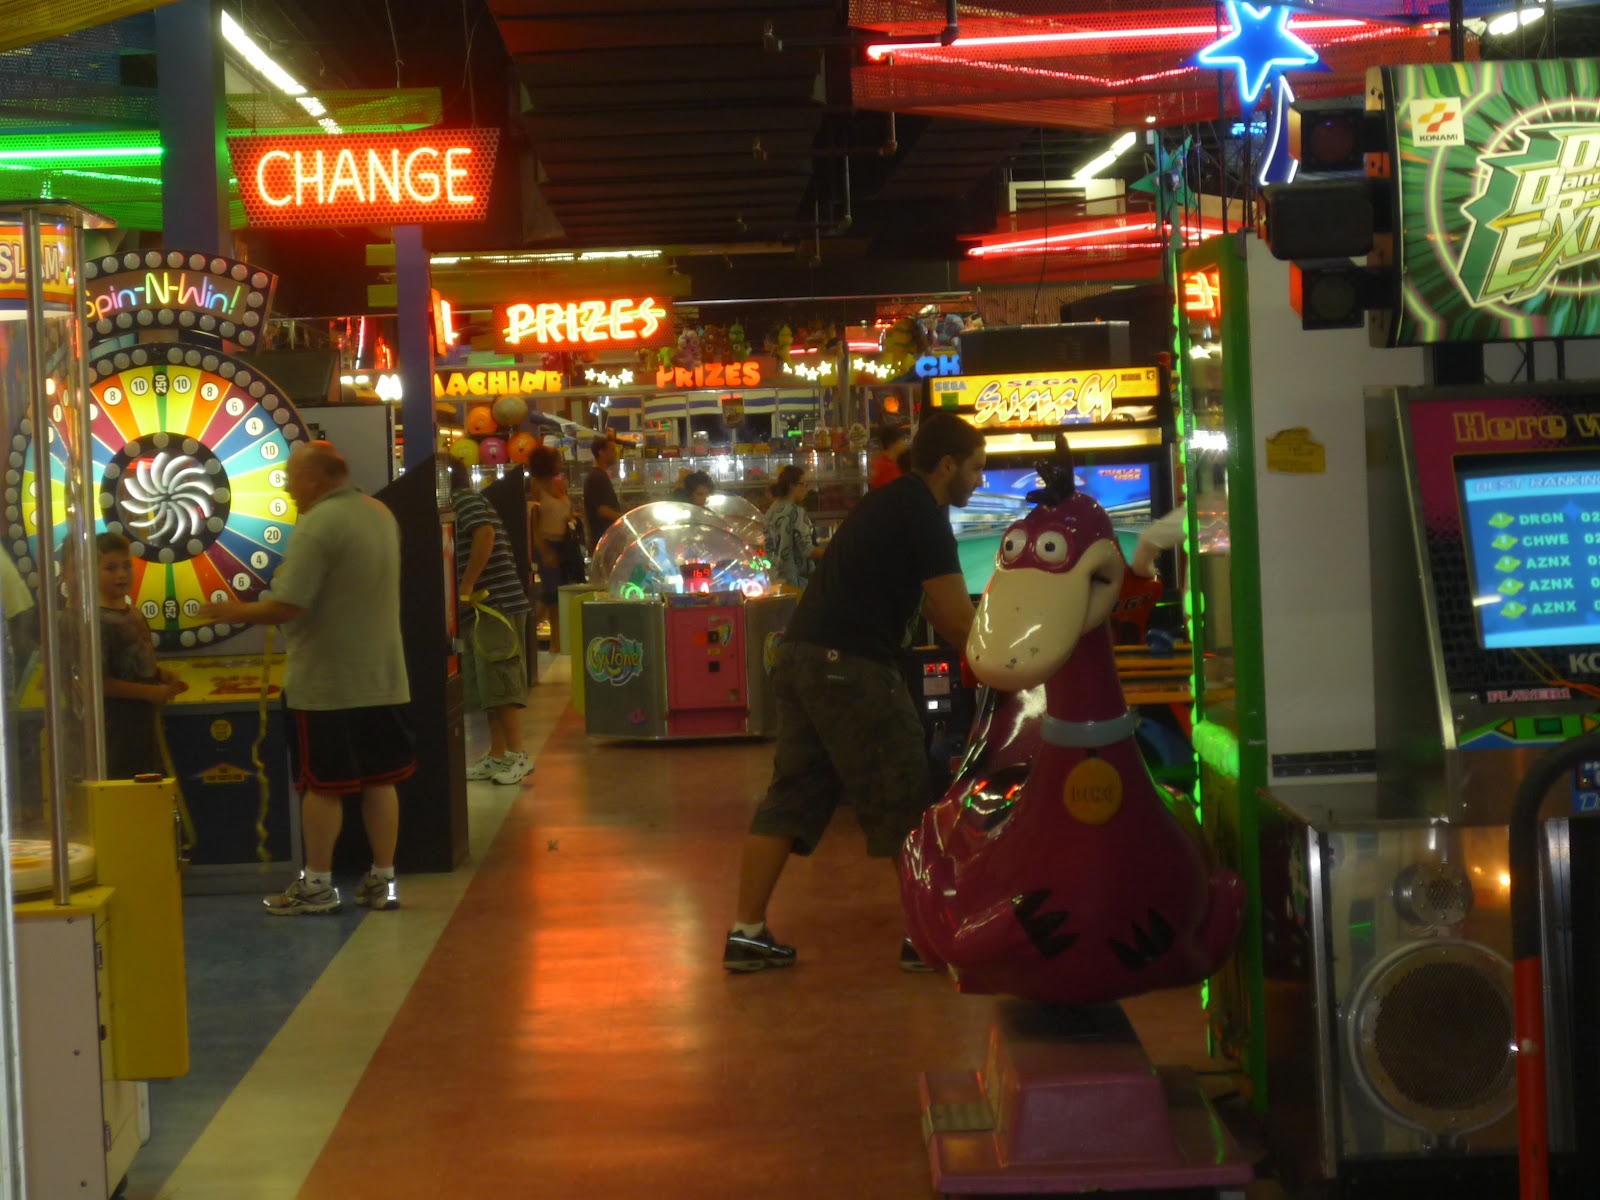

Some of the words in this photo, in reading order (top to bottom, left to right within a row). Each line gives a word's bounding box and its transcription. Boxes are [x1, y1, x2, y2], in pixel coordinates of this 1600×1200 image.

[1419, 133, 1459, 142] KONAMI
[255, 147, 475, 207] CHANGE
[0, 243, 60, 281] SLM
[502, 297, 667, 344] PRIZES
[656, 362, 761, 389] PRIZES
[133, 380, 146, 392] 10
[156, 374, 167, 394] 250
[176, 379, 188, 391] 10
[934, 380, 968, 392] SEGA
[1007, 377, 1079, 387] SEGA
[108, 391, 117, 402] 8
[206, 386, 214, 397] 8
[230, 401, 239, 412] 6
[250, 421, 259, 431] 4
[264, 445, 276, 456] 10
[274, 502, 282, 513] 6
[1519, 512, 1564, 526] DRGN
[266, 530, 279, 541] 20
[1522, 533, 1570, 547] CHWE
[255, 555, 263, 566] 4
[1526, 555, 1571, 569] AZNX
[1587, 555, 1600, 566] 0
[238, 577, 245, 588] 6
[1529, 577, 1574, 592] AZNX
[144, 604, 155, 615] 10
[165, 599, 177, 619] 250
[186, 603, 198, 614] 10
[1532, 600, 1577, 615] AZNX
